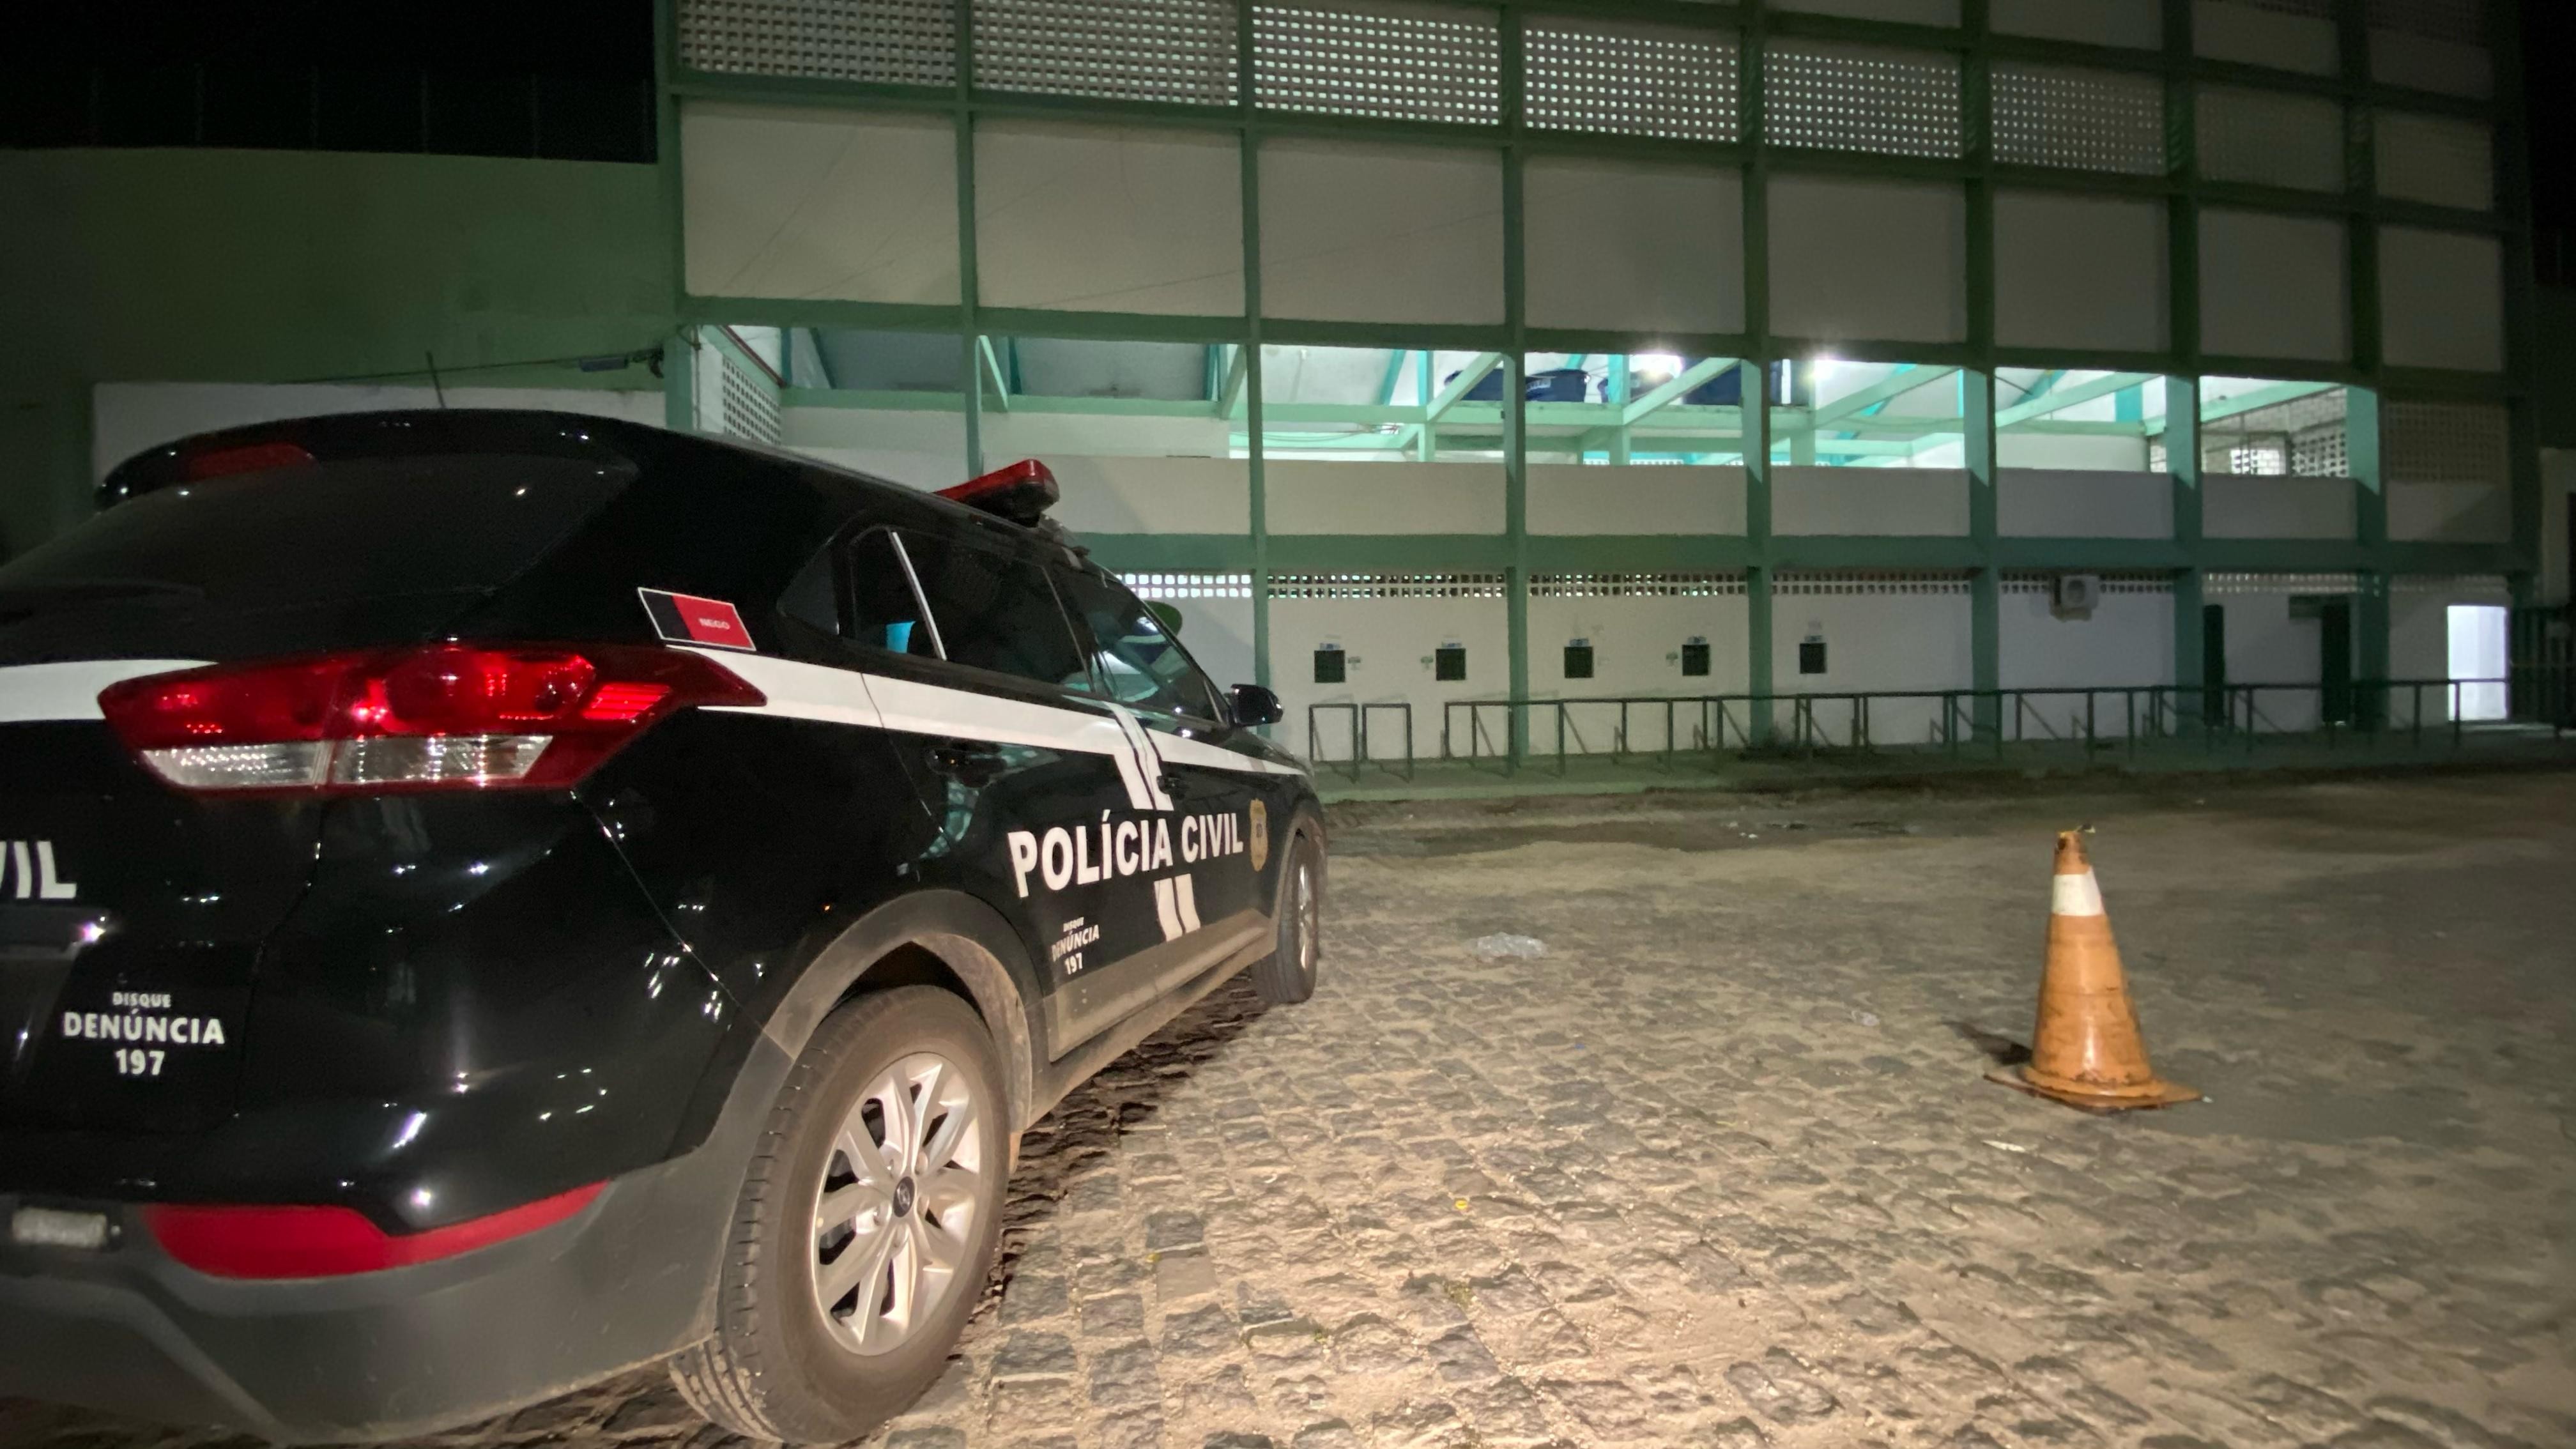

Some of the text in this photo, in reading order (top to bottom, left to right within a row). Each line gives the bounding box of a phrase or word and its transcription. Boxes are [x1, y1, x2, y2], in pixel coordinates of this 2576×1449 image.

[1008, 809, 1243, 898] POLÍCIA CIVIL
[0, 840, 77, 899] IL
[1064, 953, 1083, 975] 197
[112, 992, 171, 1008] DISQUE
[63, 1008, 225, 1044] DENÚNCIA
[116, 1048, 165, 1075] 197
